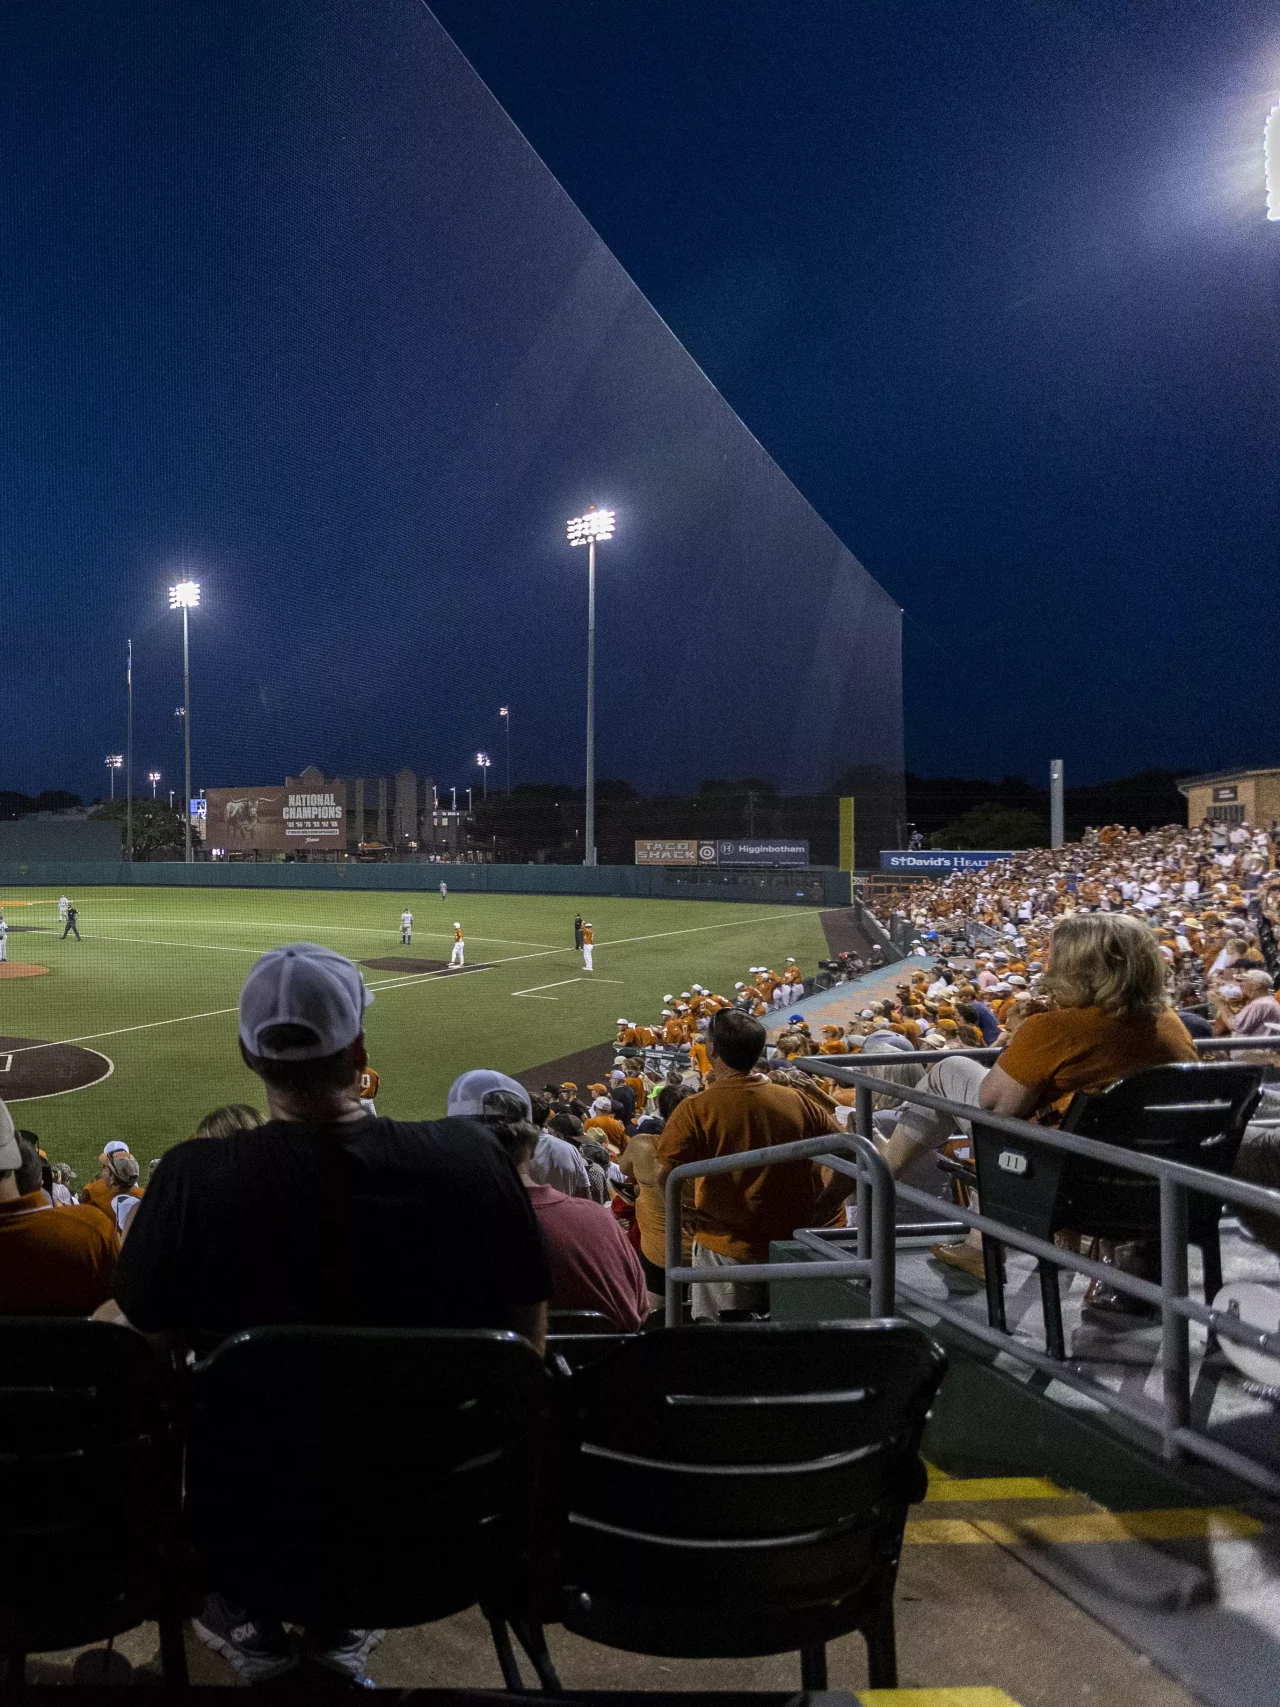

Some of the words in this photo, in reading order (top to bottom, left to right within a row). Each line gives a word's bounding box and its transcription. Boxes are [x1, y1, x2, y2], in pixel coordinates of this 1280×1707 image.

[289, 794, 336, 806] NATIONAL
[283, 807, 342, 819] CHAMPIONS
[644, 842, 689, 850] TACO
[739, 845, 805, 854] Higginbotham
[638, 851, 695, 859] SHACK
[1006, 1155, 1019, 1169] 11
